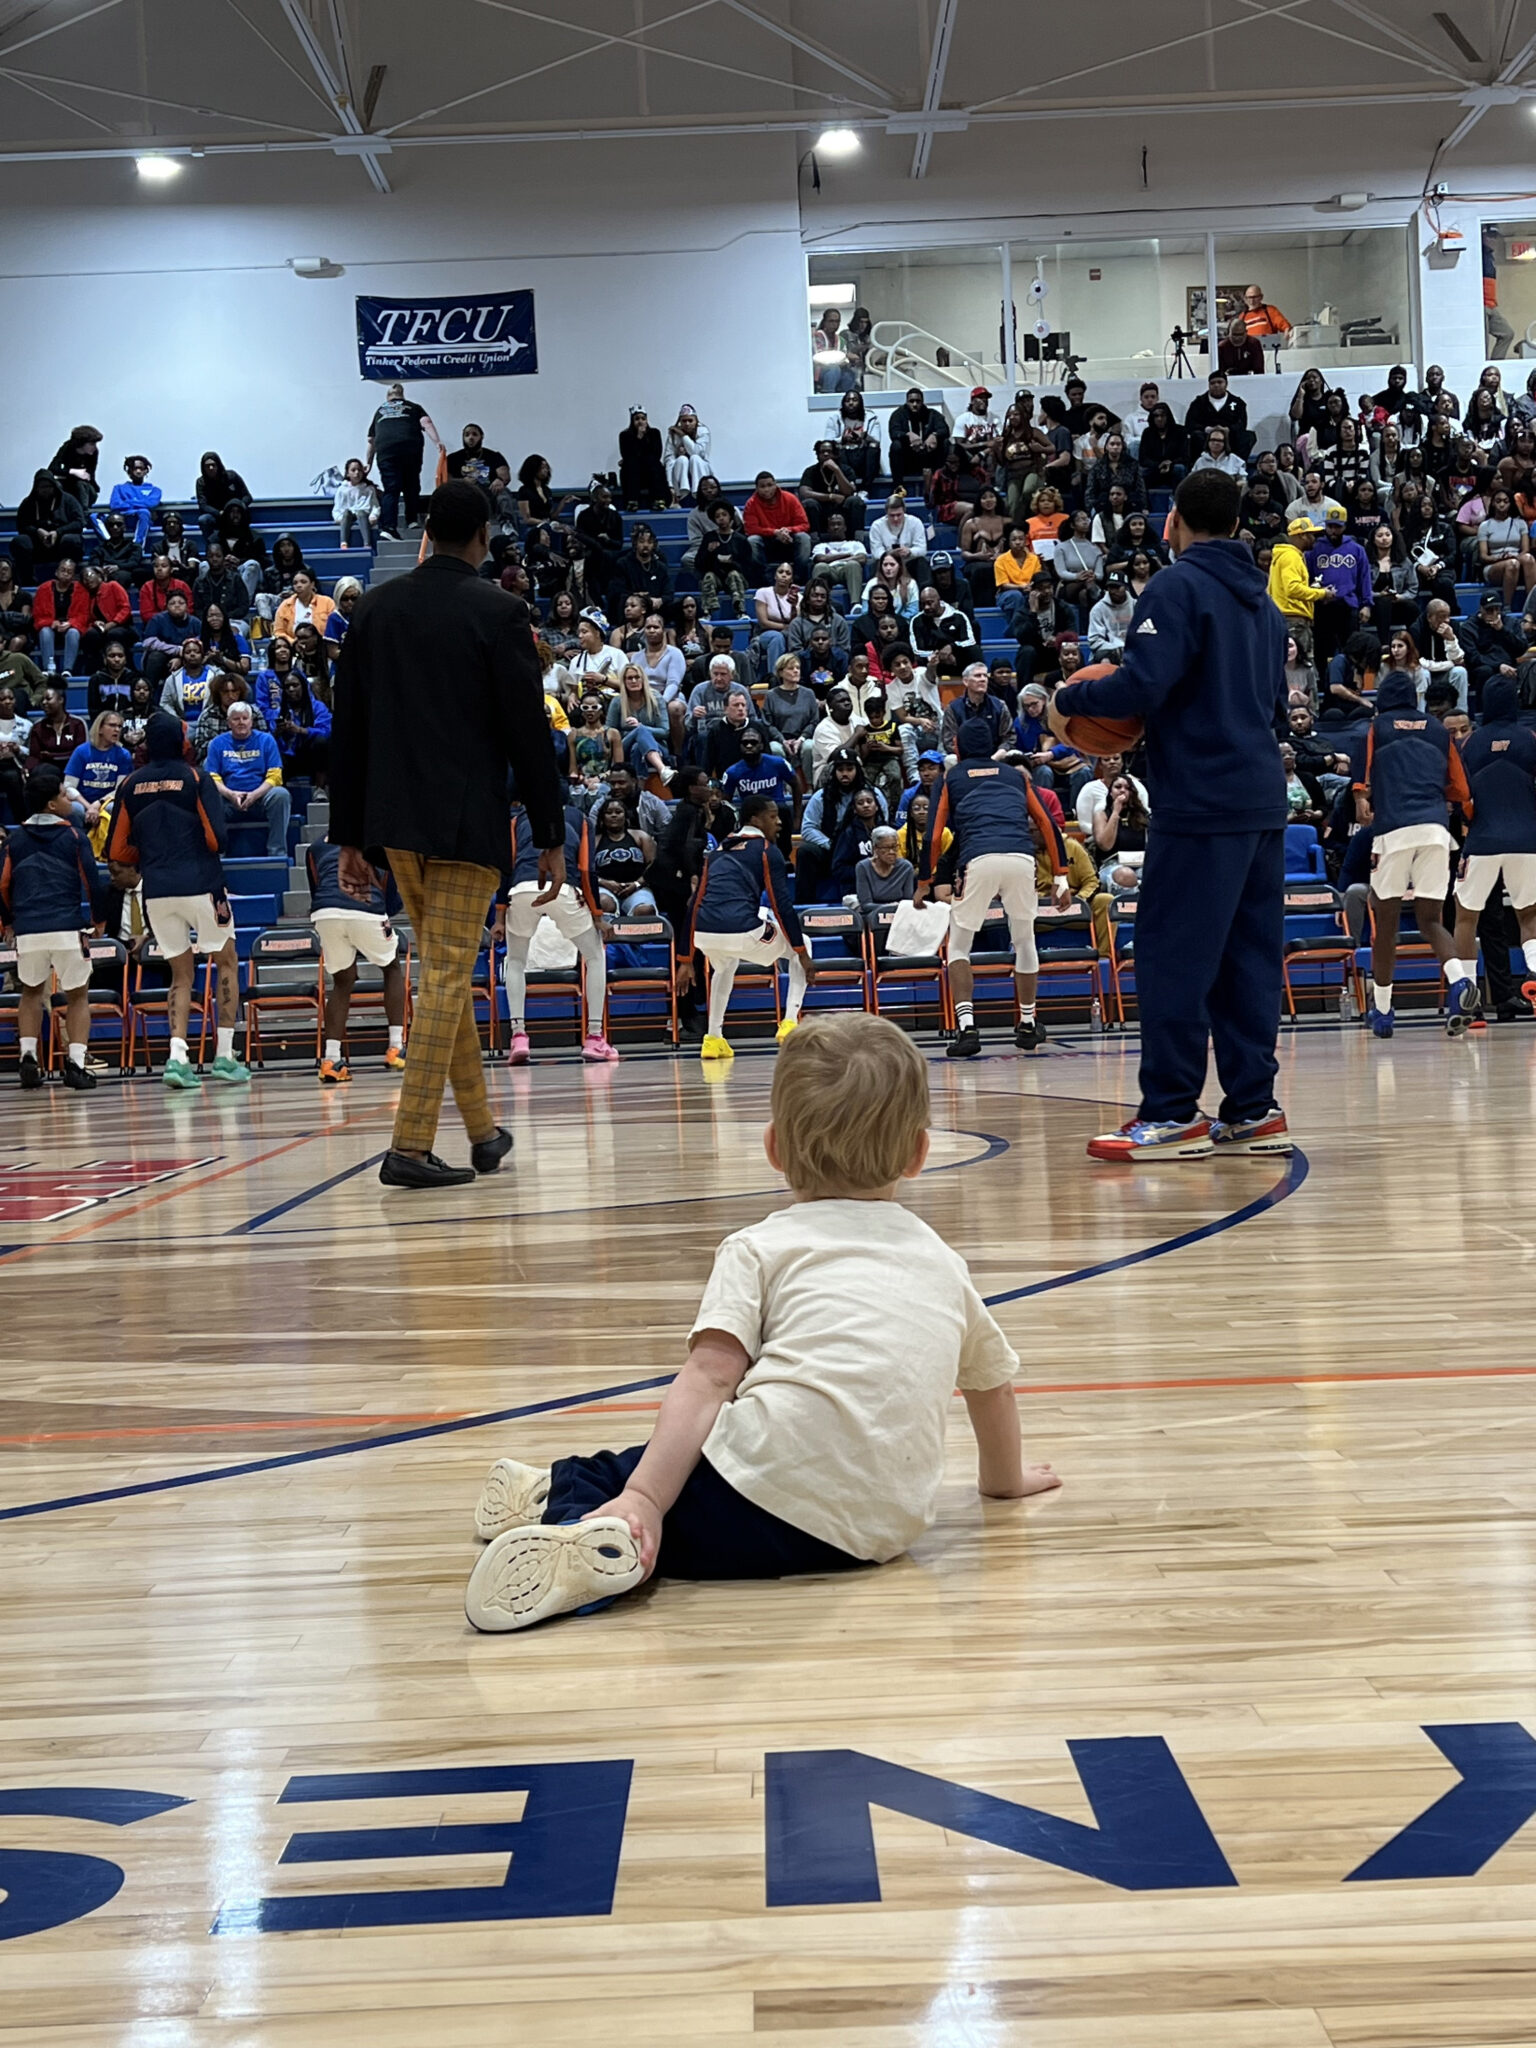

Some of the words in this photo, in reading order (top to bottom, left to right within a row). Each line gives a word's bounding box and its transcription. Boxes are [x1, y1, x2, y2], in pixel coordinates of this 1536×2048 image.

[376, 305, 514, 346] TFCU
[366, 356, 400, 366] Tinker
[402, 355, 441, 366] Federal
[443, 354, 476, 365] Credit
[479, 352, 510, 364] Union
[738, 775, 778, 794] Sigma
